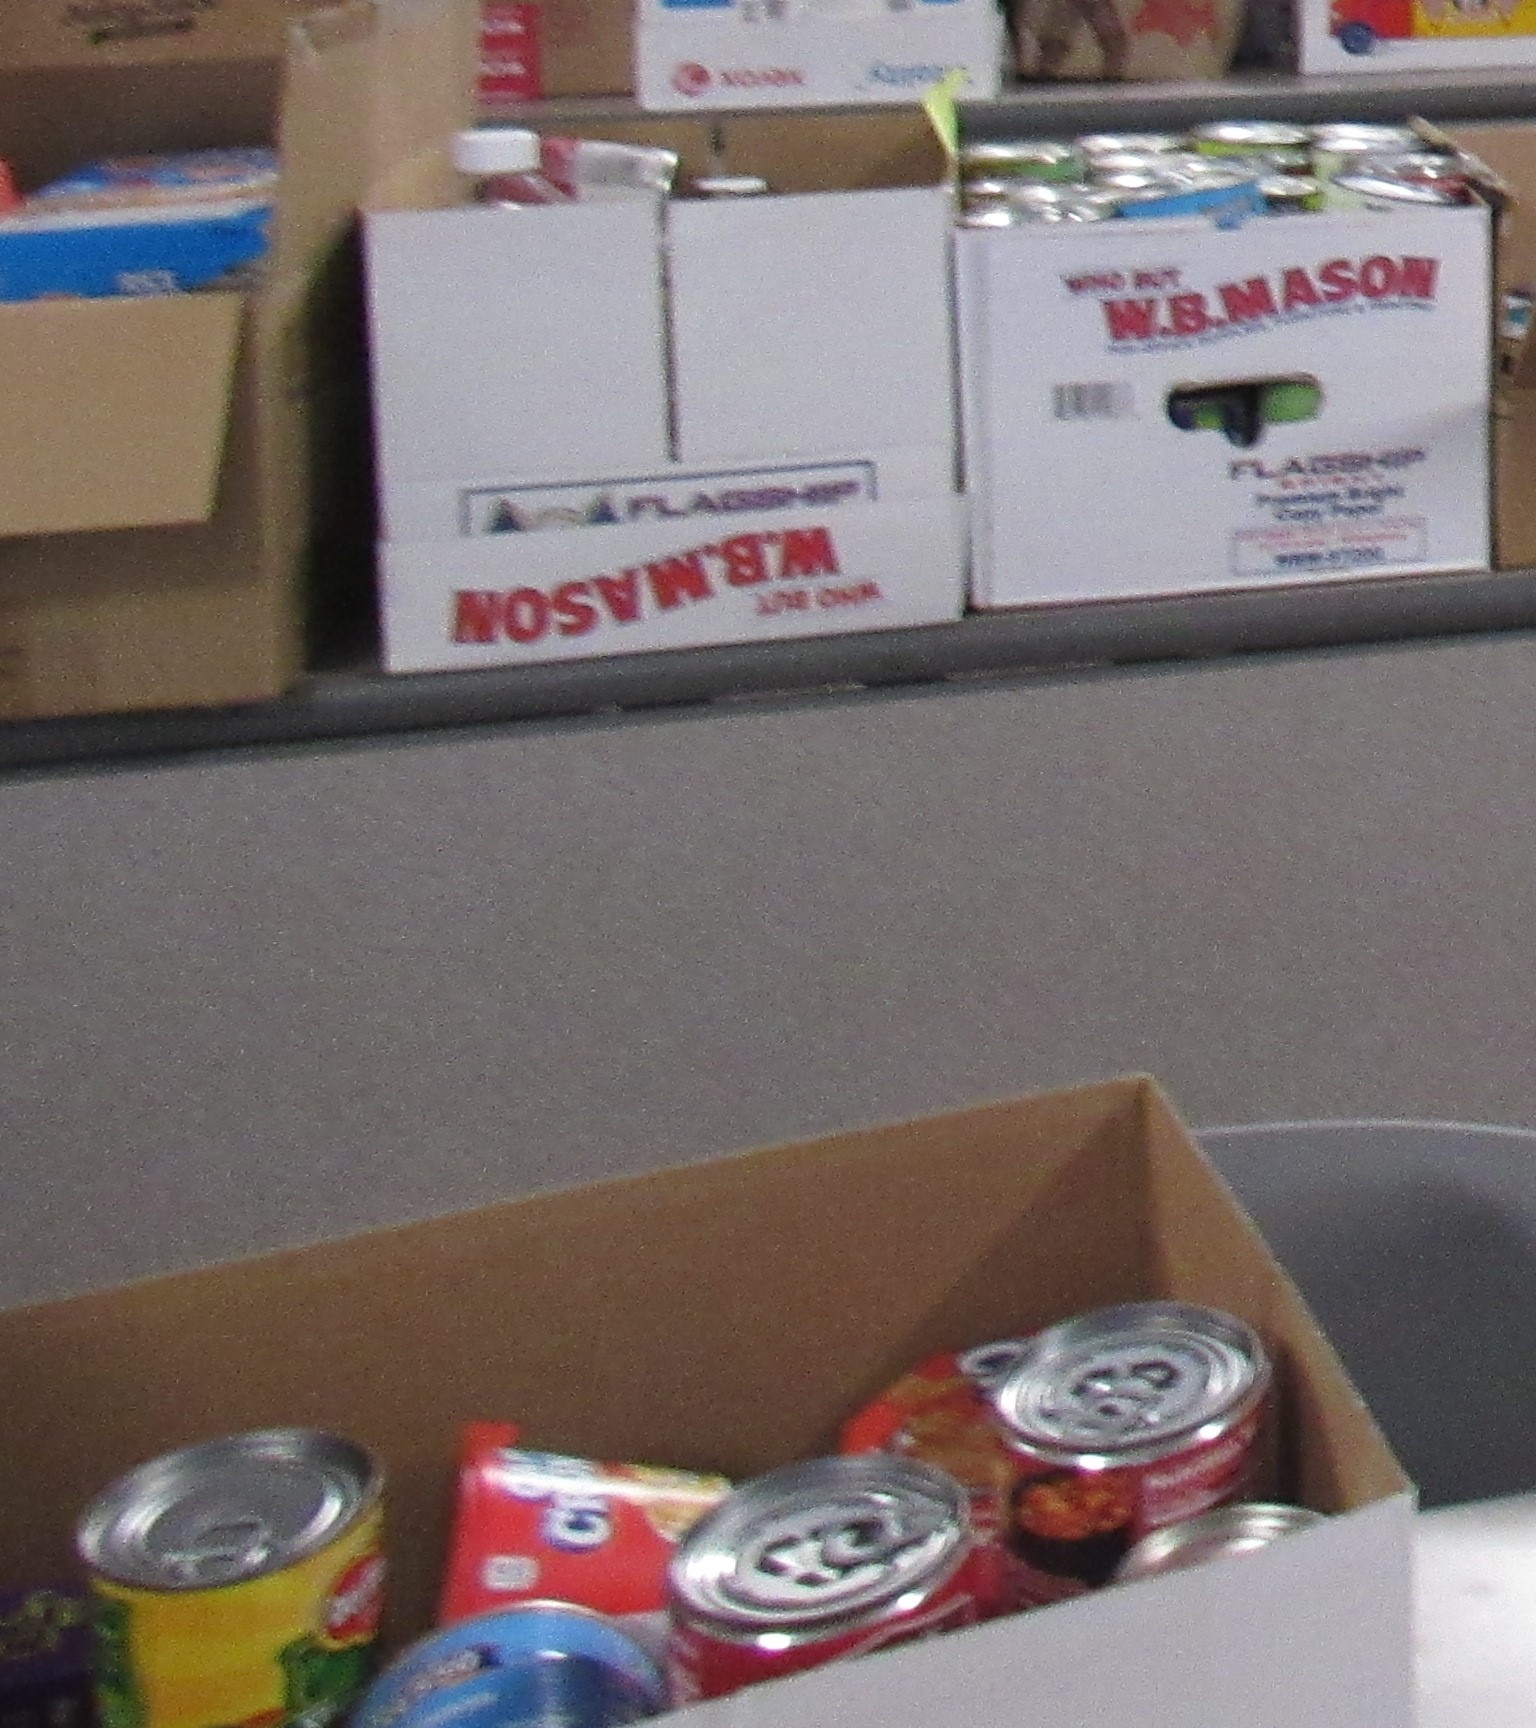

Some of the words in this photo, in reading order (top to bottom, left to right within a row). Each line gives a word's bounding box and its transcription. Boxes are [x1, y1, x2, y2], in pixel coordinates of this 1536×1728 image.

[1101, 254, 1440, 343] W.B.MASON
[449, 525, 841, 644] W.B.MASON
[754, 588, 810, 616] BUT
[815, 580, 884, 610] WHO
